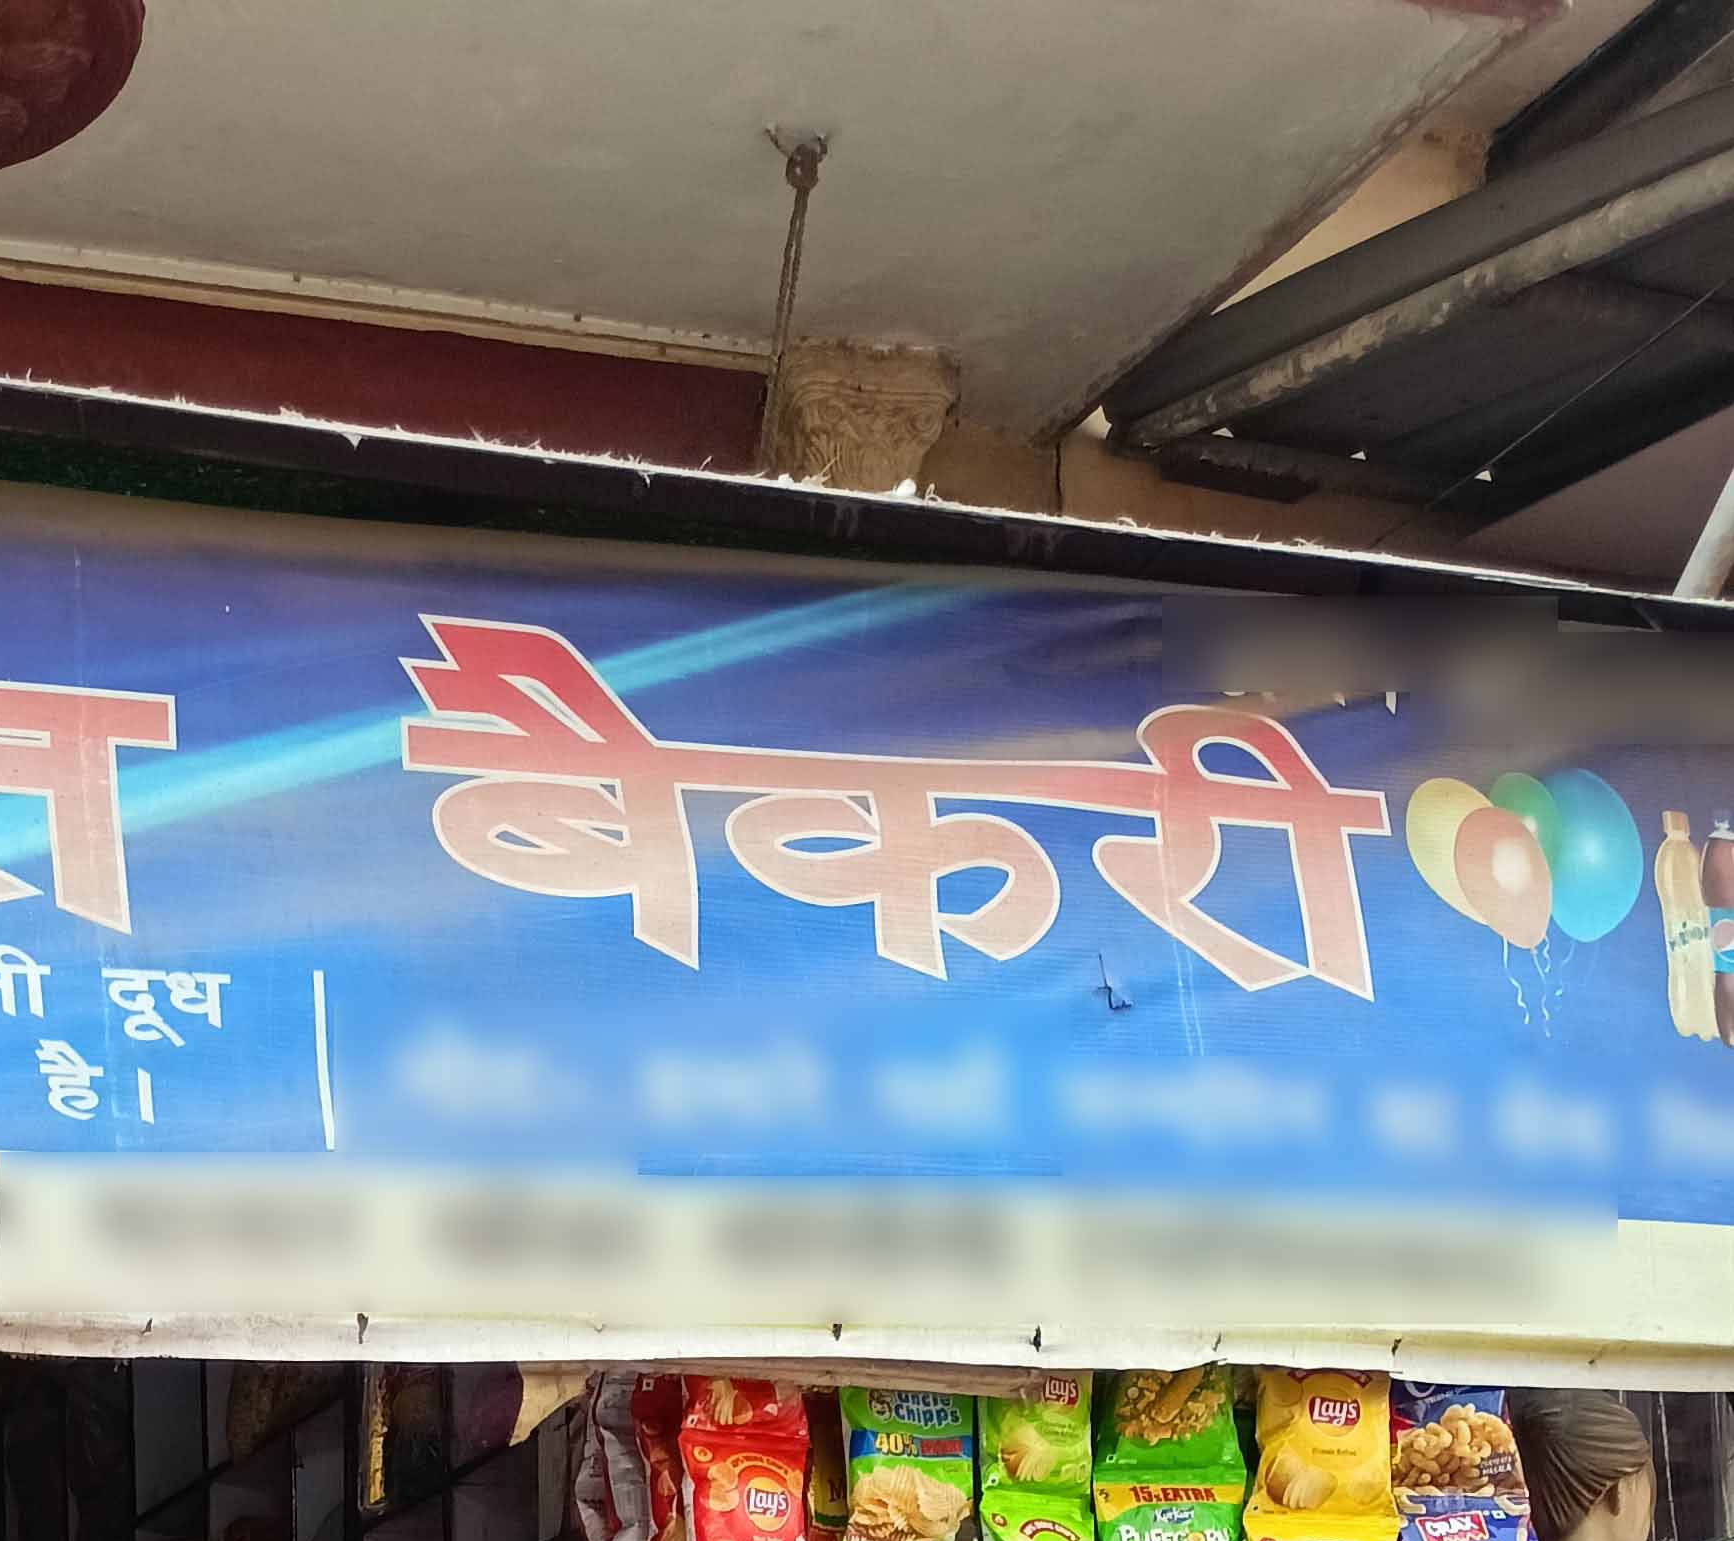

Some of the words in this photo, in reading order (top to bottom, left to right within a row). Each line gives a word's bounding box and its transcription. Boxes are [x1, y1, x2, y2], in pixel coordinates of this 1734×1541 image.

[102, 968, 230, 1047] दूध
[1044, 1379, 1079, 1406] Lay's
[894, 1403, 960, 1426] Chipps
[1311, 1397, 1358, 1425] Lay's
[875, 1433, 917, 1457] 40%
[750, 1490, 787, 1516] Lay's
[1425, 1517, 1477, 1537] CRAX
